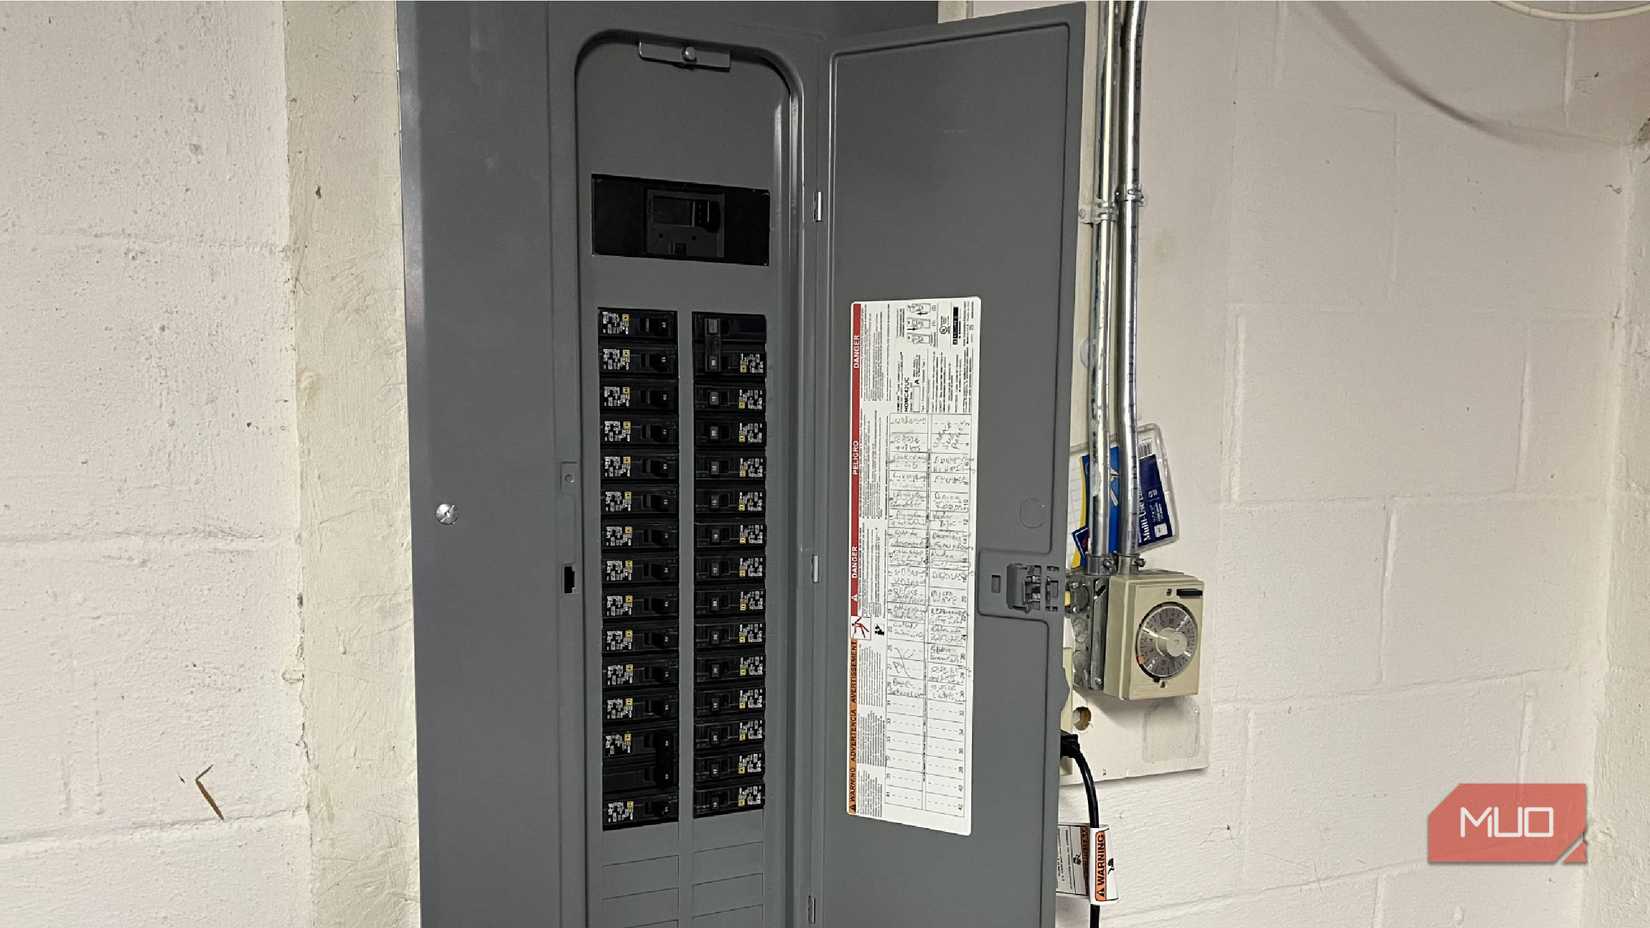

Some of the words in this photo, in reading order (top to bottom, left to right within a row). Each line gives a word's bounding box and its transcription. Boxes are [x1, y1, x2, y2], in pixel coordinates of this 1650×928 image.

[853, 335, 861, 368] DANGER
[850, 641, 858, 702] AVERTISSEMENT
[849, 767, 857, 801] WARNING
[1097, 834, 1105, 886] WARNING
